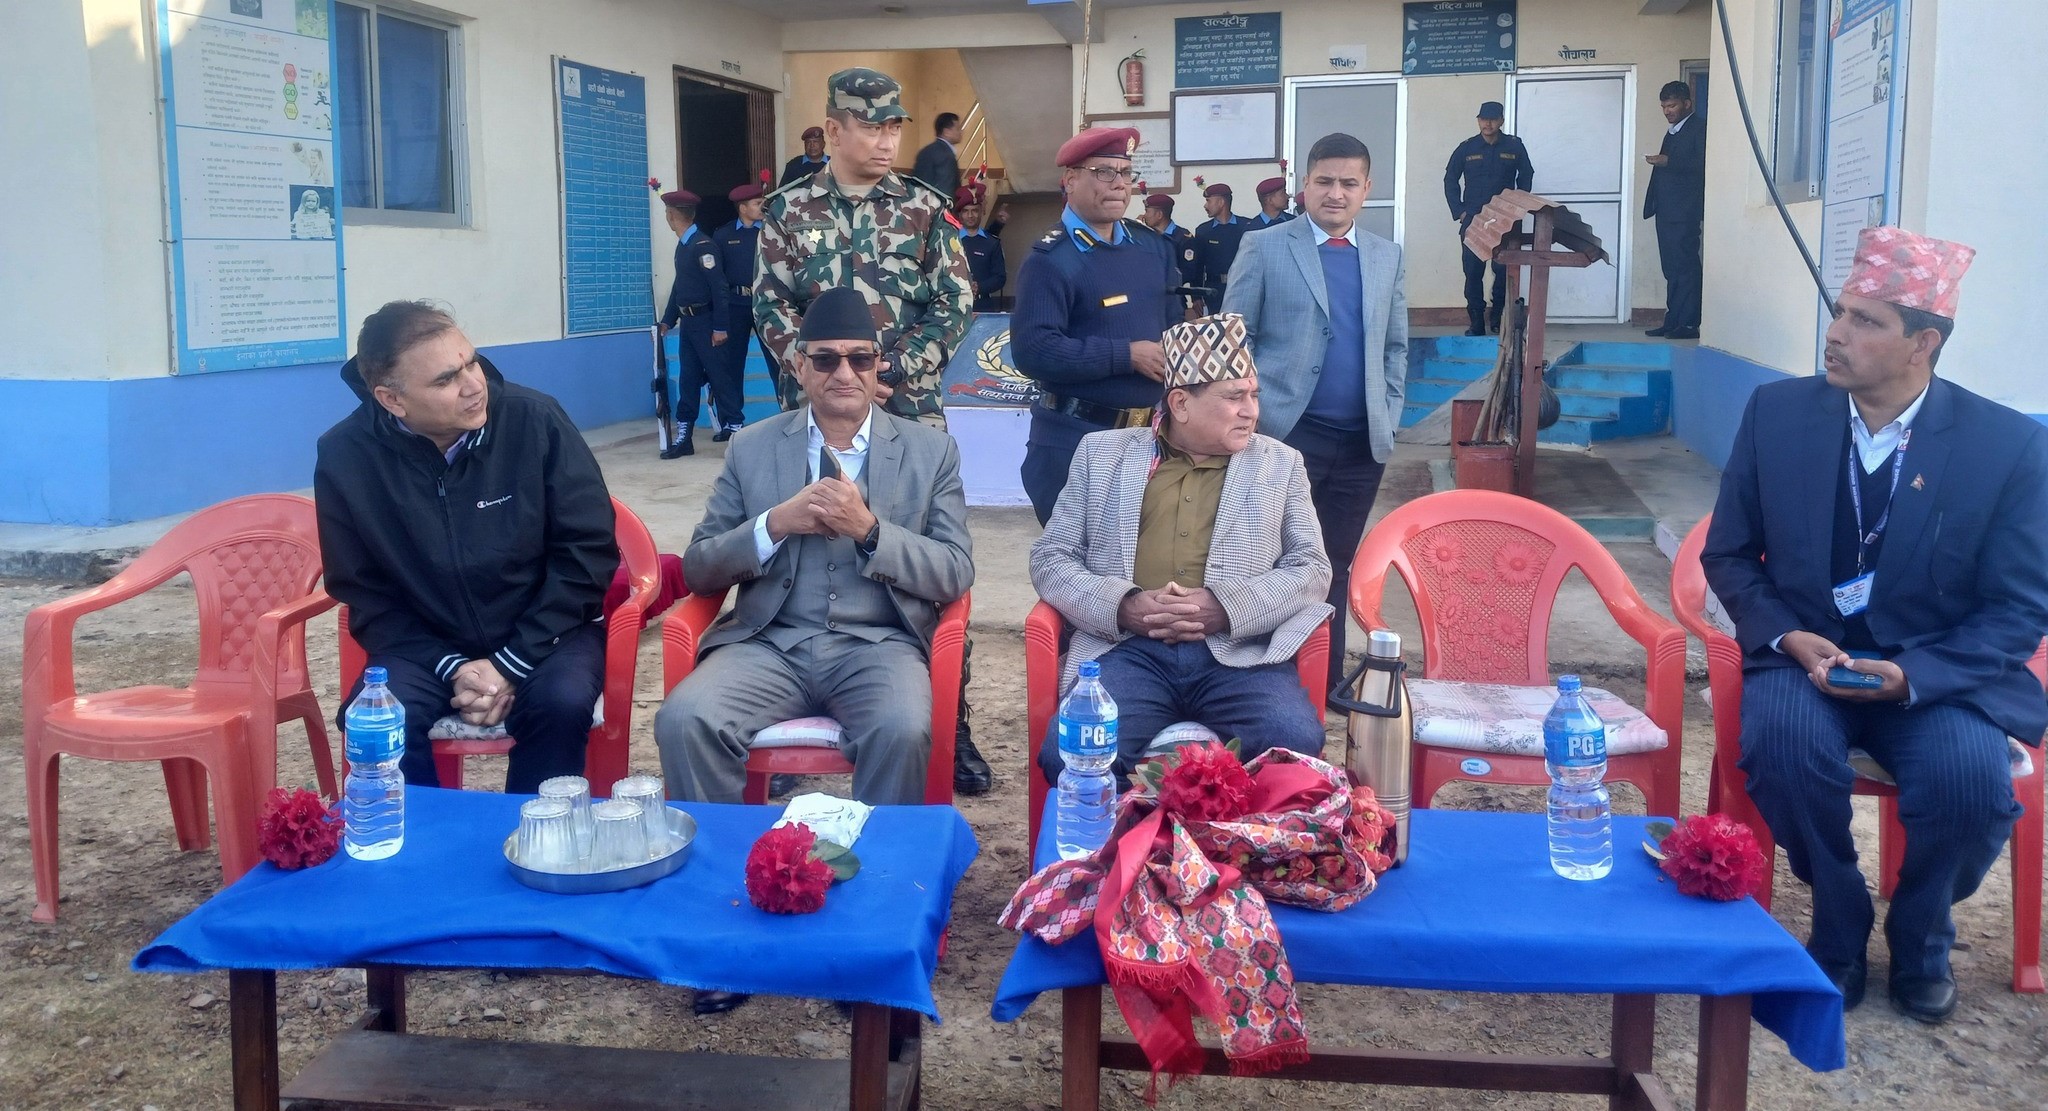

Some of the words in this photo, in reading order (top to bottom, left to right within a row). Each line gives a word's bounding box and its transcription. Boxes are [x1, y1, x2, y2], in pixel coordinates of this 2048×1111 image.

[1465, 1, 1483, 9] गान
[1558, 45, 1597, 62] शौचालय
[476, 495, 512, 509] Champion
[1080, 725, 1105, 746] PG
[1567, 735, 1595, 757] PG
